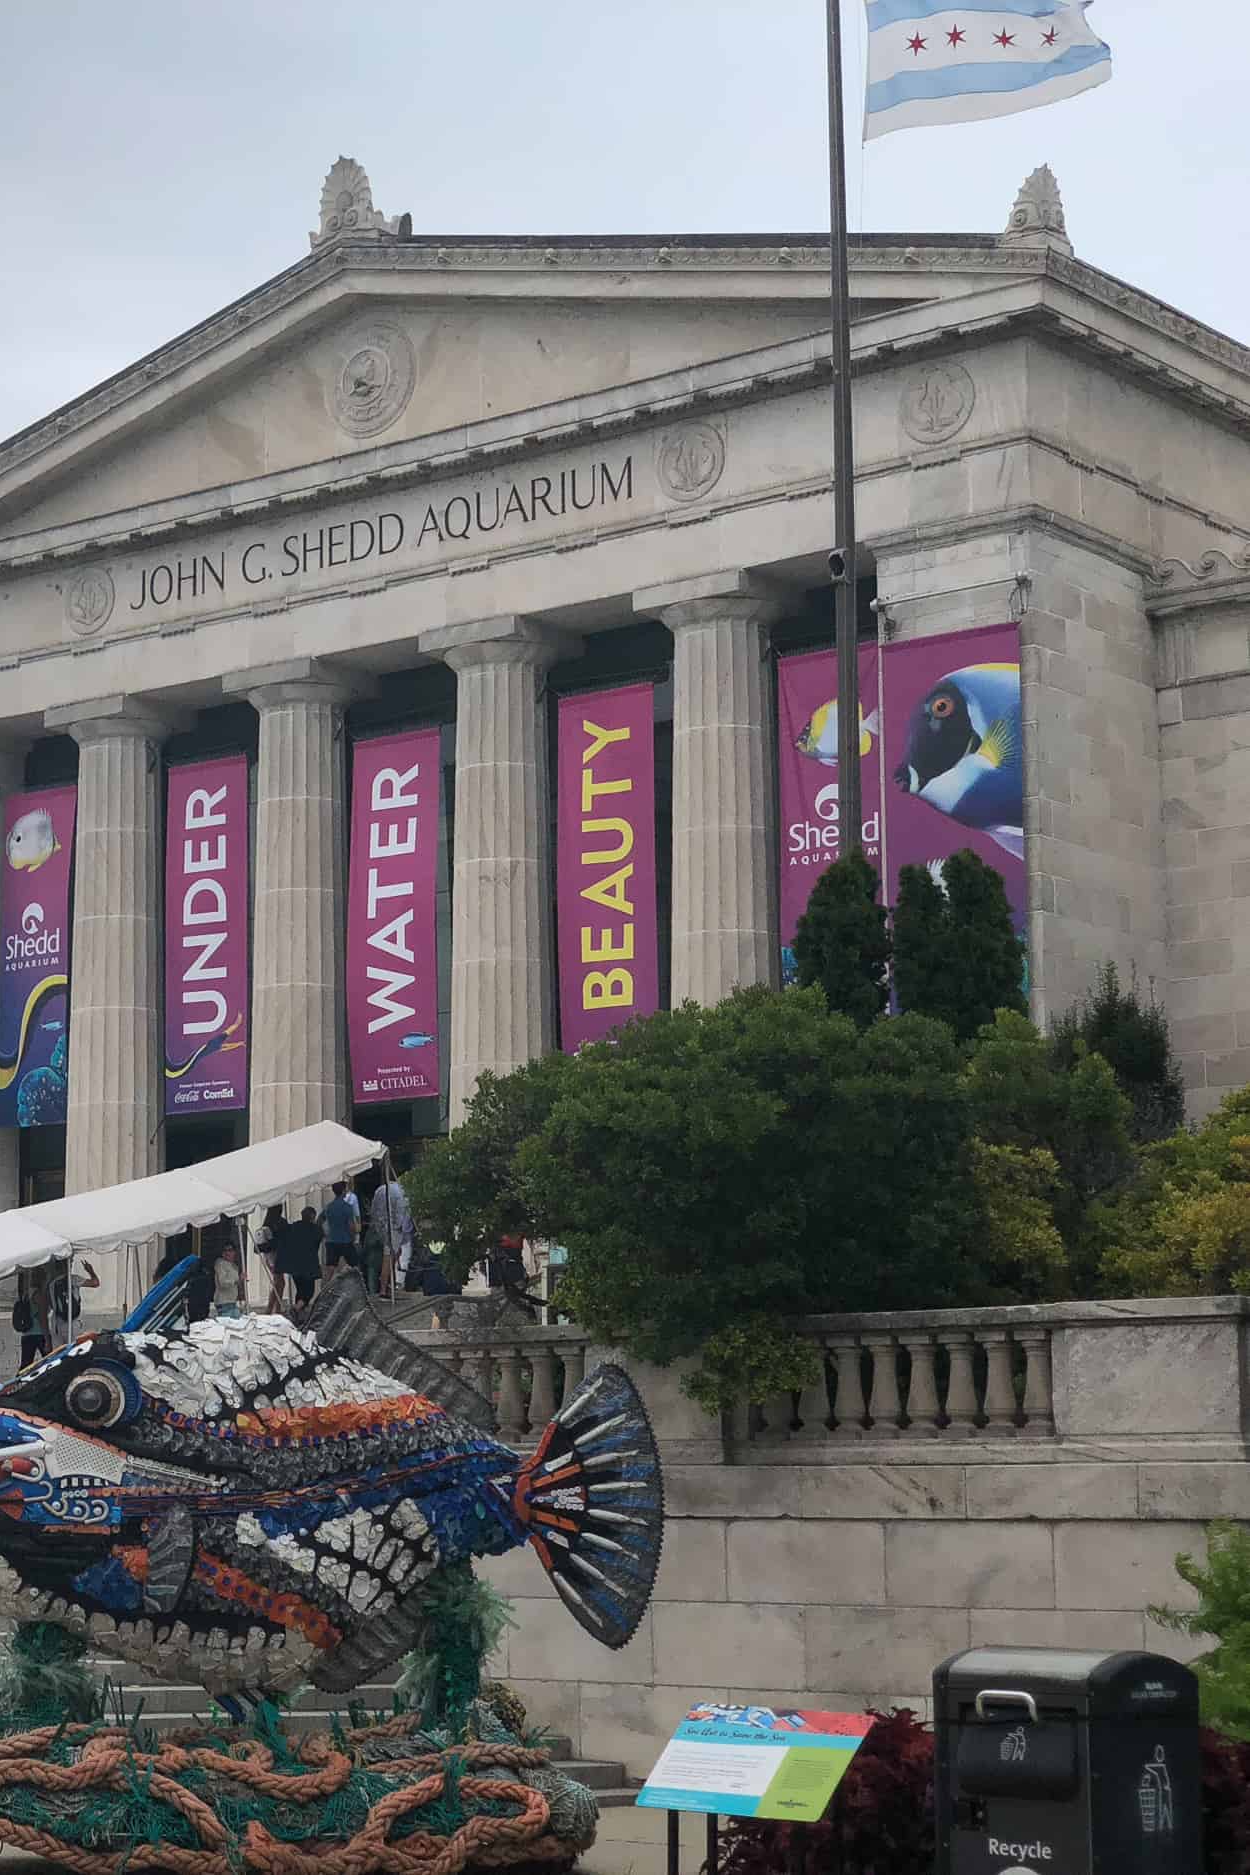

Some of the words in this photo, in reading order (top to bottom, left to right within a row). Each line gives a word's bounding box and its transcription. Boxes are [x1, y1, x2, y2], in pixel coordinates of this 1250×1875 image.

[130, 551, 225, 610] JOHN
[241, 543, 273, 584] G.
[281, 512, 404, 577] SHEDD
[417, 456, 634, 547] AQUARIUM
[788, 811, 879, 852] Shed
[580, 719, 635, 1010] BEAUTY
[790, 846, 879, 866] AQUAM
[182, 784, 228, 1035] UNDER
[366, 763, 419, 1034] WATER
[5, 927, 60, 960] Shedd
[5, 957, 60, 971] AQUARIUM
[380, 1074, 428, 1090] CITADEL
[988, 1838, 1052, 1862] Recycle
